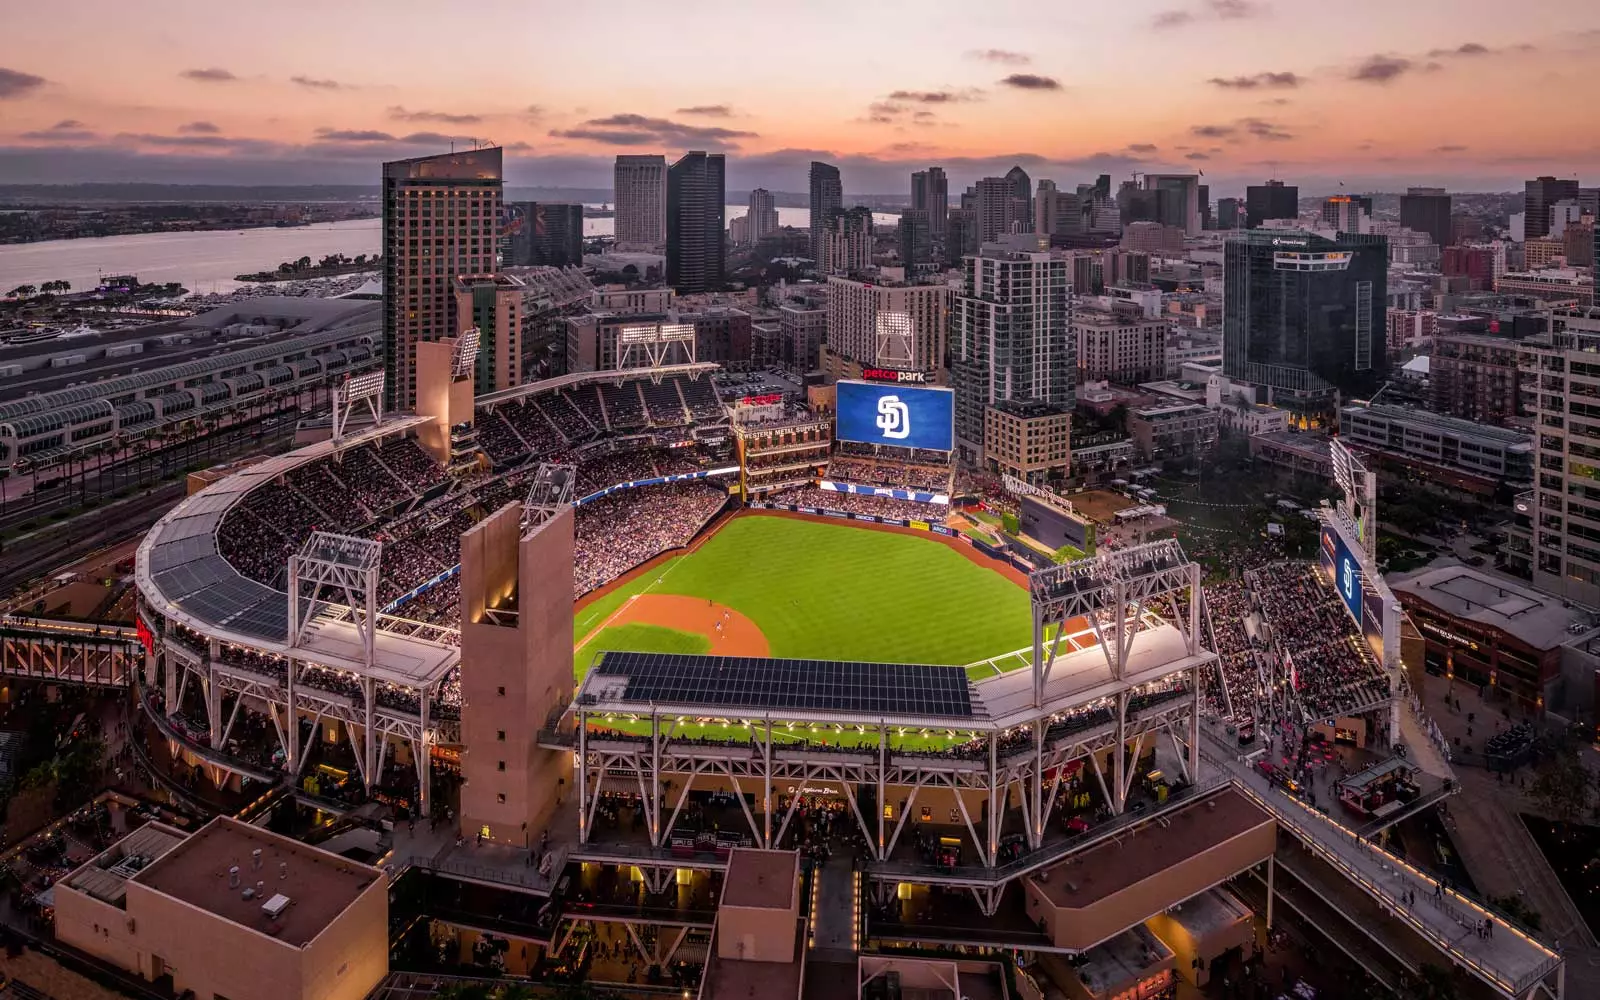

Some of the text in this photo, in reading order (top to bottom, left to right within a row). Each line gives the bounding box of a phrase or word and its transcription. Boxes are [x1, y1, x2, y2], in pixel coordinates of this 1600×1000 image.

[863, 369, 925, 382] petcopark
[877, 395, 910, 439] SD
[744, 431, 772, 439] WESTERN
[775, 428, 793, 436] METAL
[796, 425, 819, 433] SUPPLY
[933, 526, 947, 534] ARCO
